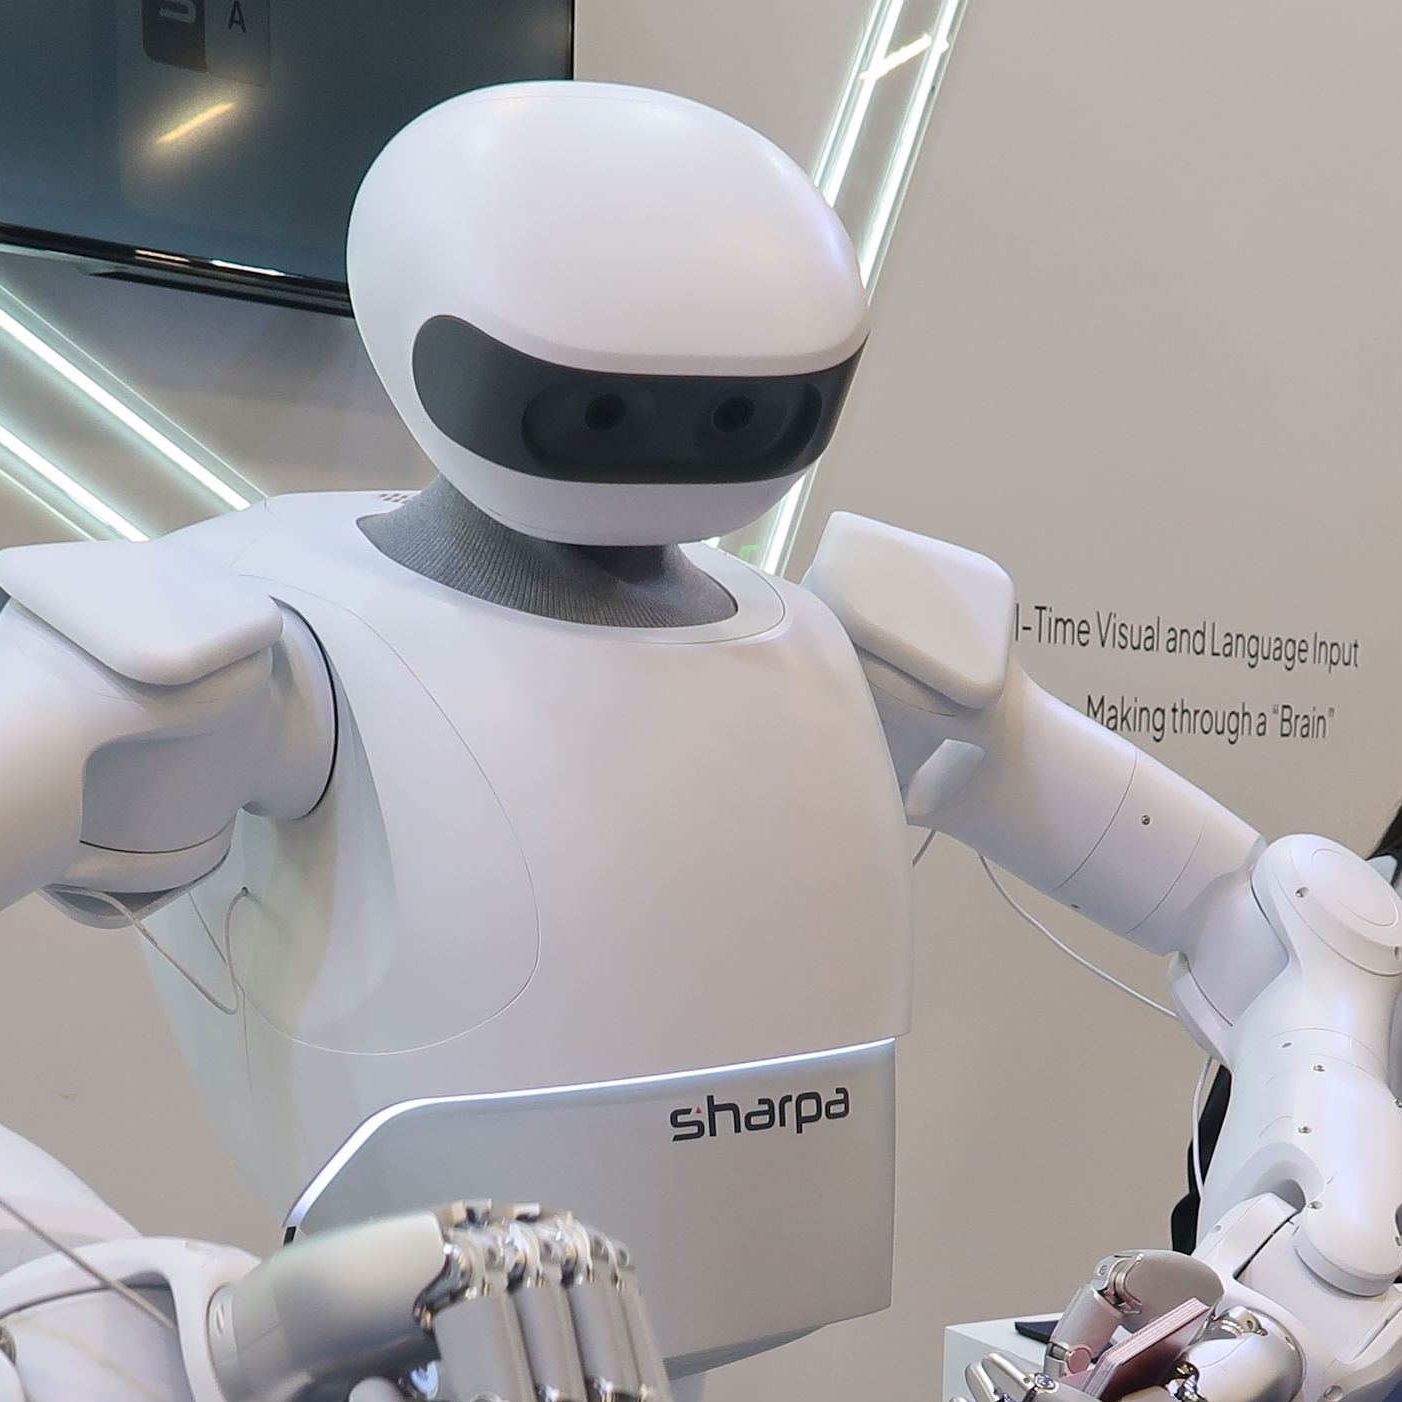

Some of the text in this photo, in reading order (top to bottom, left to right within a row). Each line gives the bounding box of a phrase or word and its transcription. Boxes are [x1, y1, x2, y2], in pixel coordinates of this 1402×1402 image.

[1096, 611, 1161, 652] Visual
[1166, 620, 1207, 656] and
[1211, 621, 1309, 671] Language
[1313, 632, 1359, 673] Input
[1086, 694, 1166, 742] Making
[1170, 698, 1252, 745] through
[1256, 711, 1267, 736] a
[669, 1086, 850, 1142] sharpa
